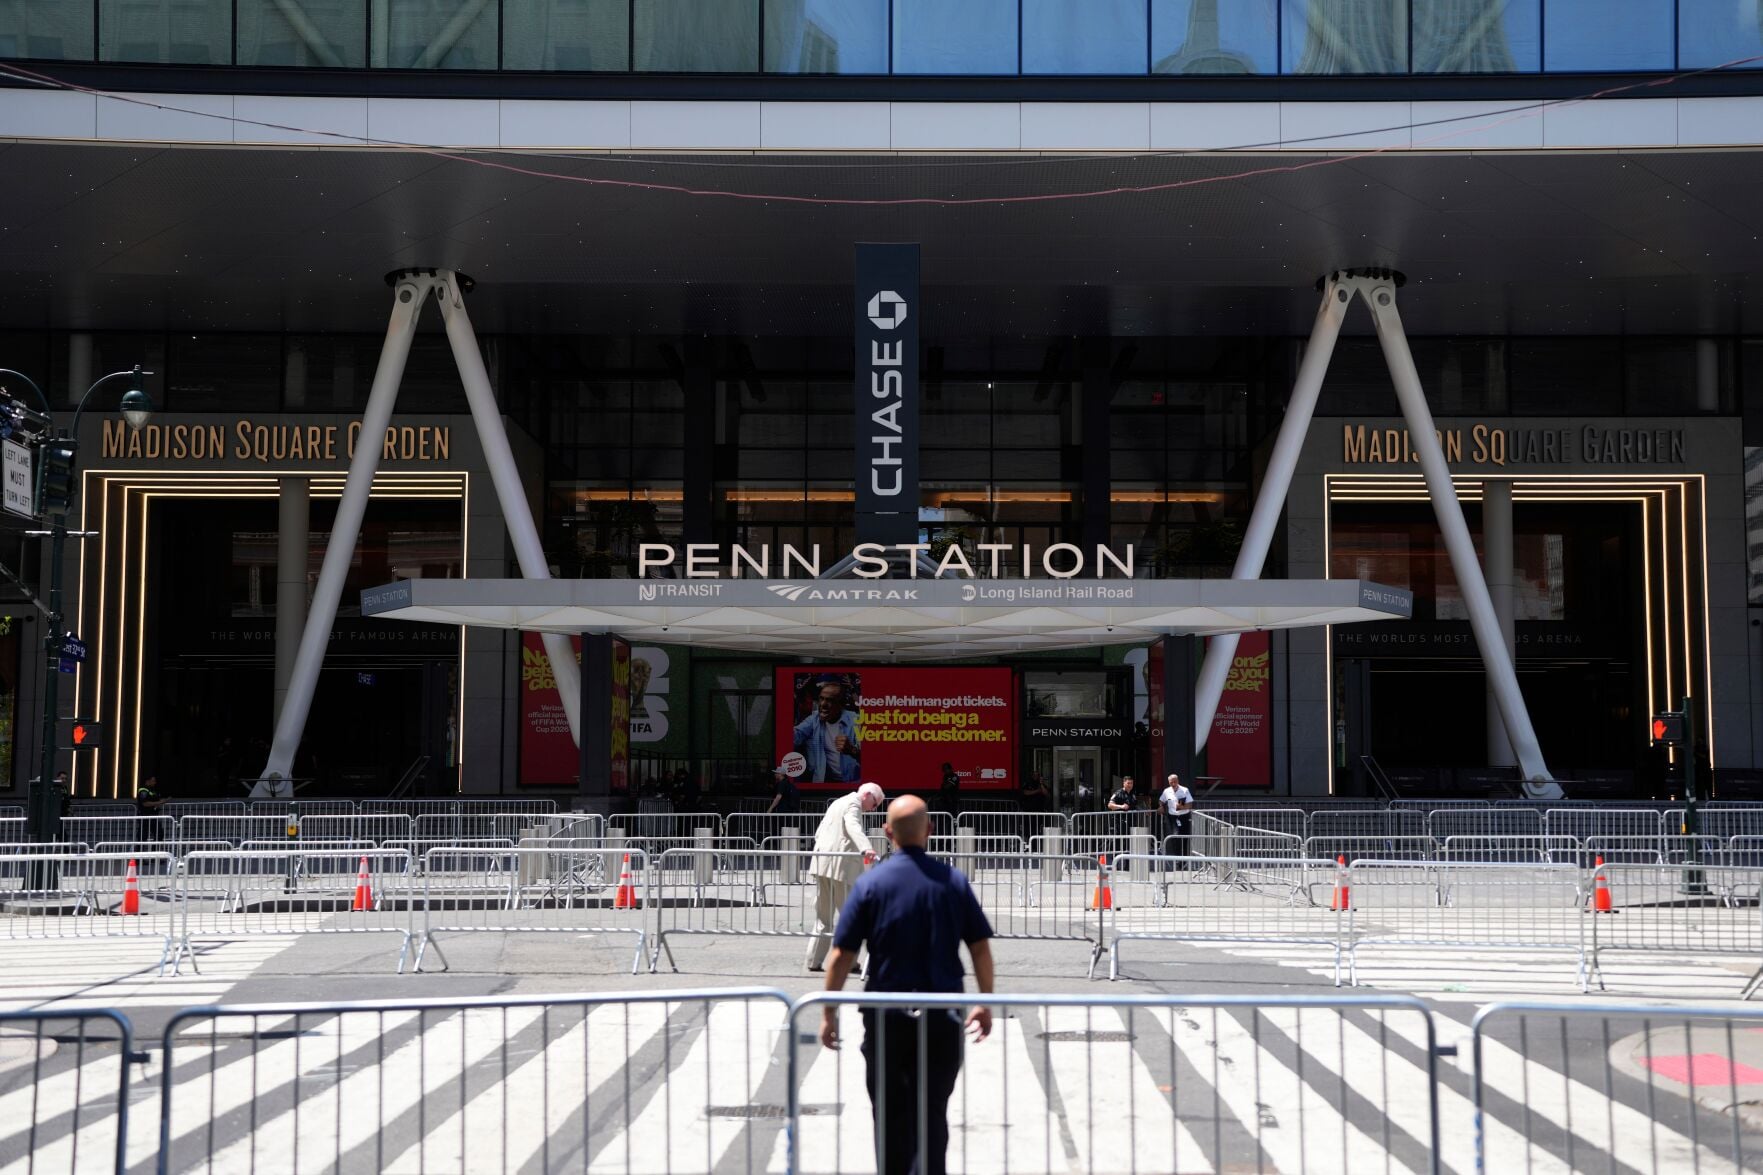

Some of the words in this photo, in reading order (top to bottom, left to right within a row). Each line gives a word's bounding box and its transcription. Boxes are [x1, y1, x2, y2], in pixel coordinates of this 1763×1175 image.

[872, 340, 902, 496] CHASE
[102, 419, 225, 459] MADISON
[235, 420, 337, 463] SQUARE
[347, 421, 449, 460] RDEN
[1344, 424, 1462, 463] MADIN
[1472, 424, 1574, 466] SQUARE
[1583, 424, 1686, 464] GARDEN
[5, 448, 16, 463] LEFT
[18, 453, 29, 468] LANE
[10, 468, 25, 487] MUST
[6, 489, 18, 503] TURN
[20, 496, 30, 508] LEFT
[639, 543, 820, 577] PENN
[852, 543, 1134, 578] STATION
[364, 594, 380, 607] PENN
[381, 588, 409, 604] STATION
[657, 584, 723, 597] TRANSIT
[808, 589, 918, 600] AMTRAK
[980, 586, 1015, 601] Long
[1019, 586, 1062, 599] Island
[1066, 586, 1094, 599] Rail
[1097, 586, 1134, 599] Road
[1363, 589, 1382, 602] PENN
[1383, 593, 1410, 609] STATION
[210, 631, 236, 640] THE
[350, 631, 405, 640] FAMOUS
[411, 631, 457, 640] ARENA
[1339, 633, 1363, 643] THE
[1434, 633, 1470, 643] MOST
[1537, 634, 1582, 643] ARENA
[1234, 650, 1270, 668] one
[1240, 667, 1269, 681] you
[1224, 680, 1263, 692] oser
[855, 696, 884, 707] Jose
[885, 696, 941, 707] Mehlman
[943, 696, 963, 709] got
[963, 696, 1007, 707] tickets.
[854, 709, 892, 725] Just
[893, 709, 918, 724] for
[918, 709, 967, 727] being
[968, 712, 979, 725] a
[630, 724, 652, 733] IFA
[854, 726, 920, 742] Verizon
[920, 727, 1007, 742] customer.
[1032, 728, 1067, 737] PENN
[1070, 728, 1122, 737] STATION
